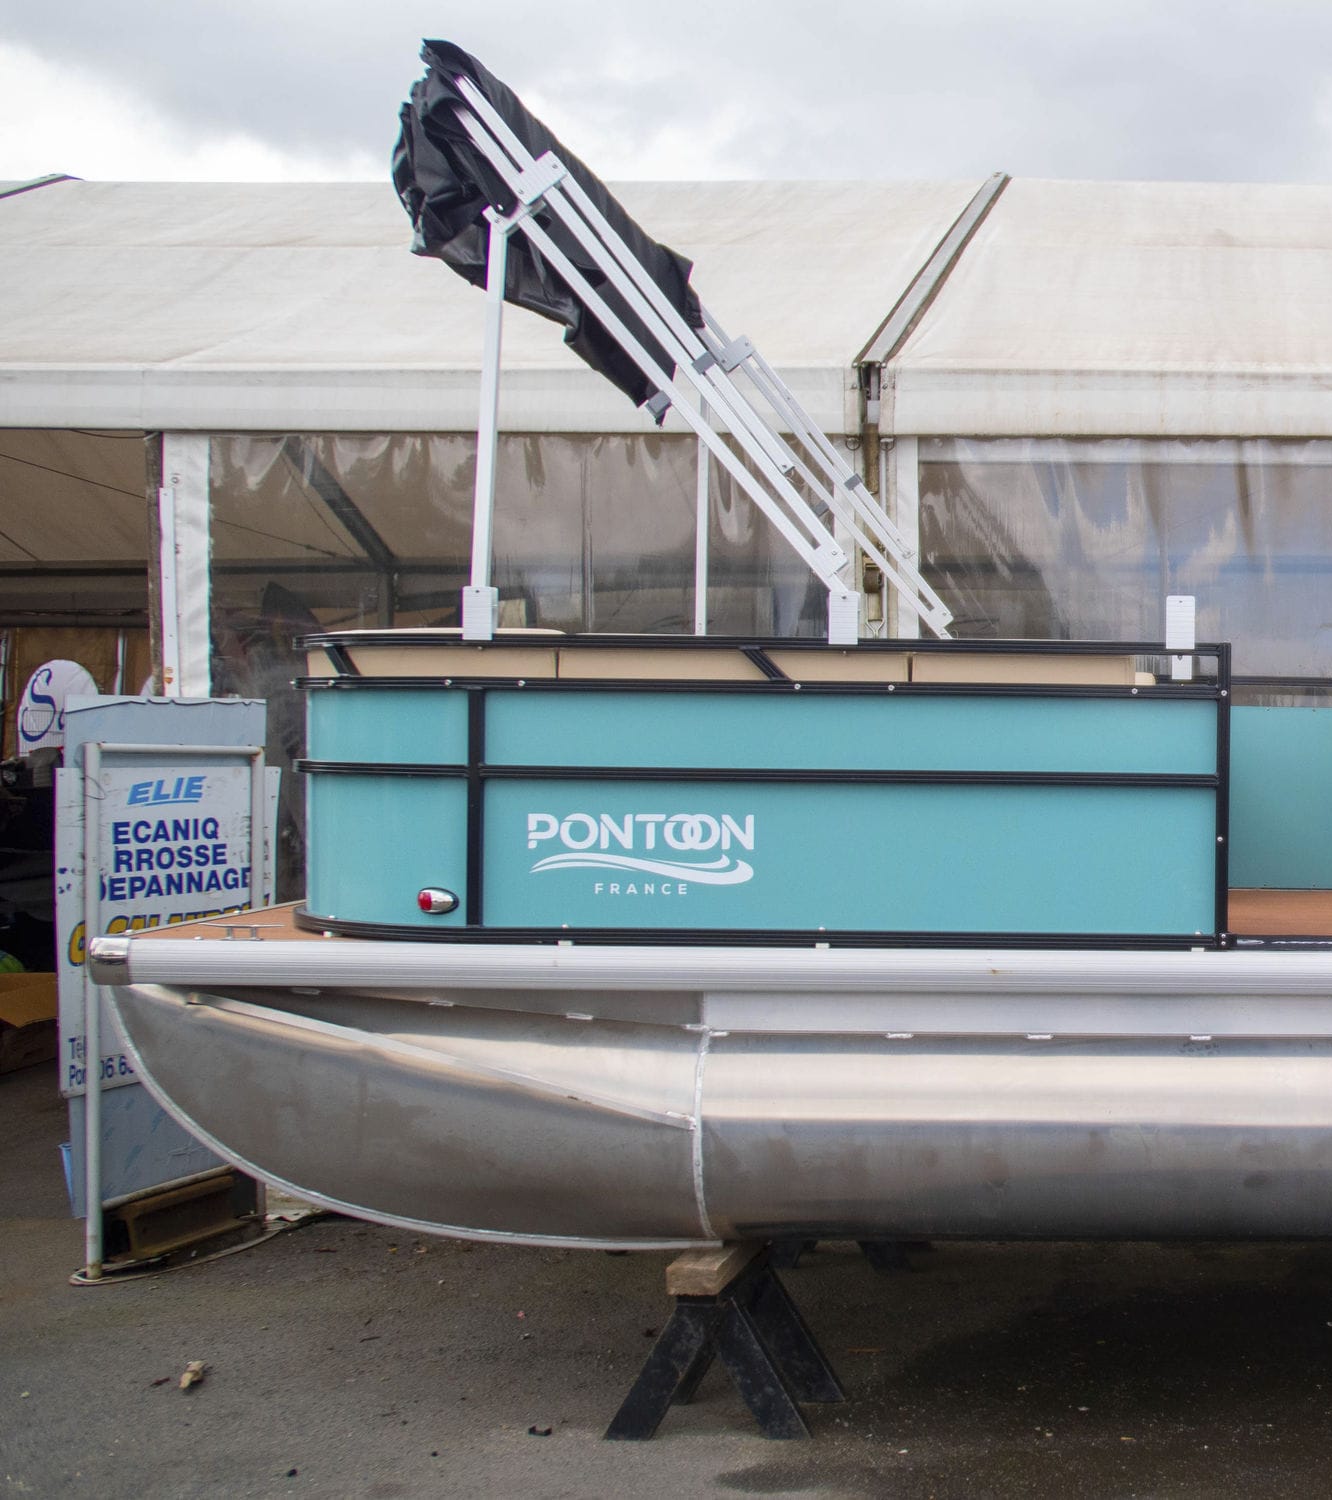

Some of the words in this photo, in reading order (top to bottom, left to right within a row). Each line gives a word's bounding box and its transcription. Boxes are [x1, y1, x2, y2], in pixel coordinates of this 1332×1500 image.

[127, 775, 207, 806] ELIE
[112, 817, 219, 845] ECANIQ
[527, 812, 755, 851] PONTOON
[114, 843, 227, 873] RROSSE
[594, 883, 688, 895] FRANCE
